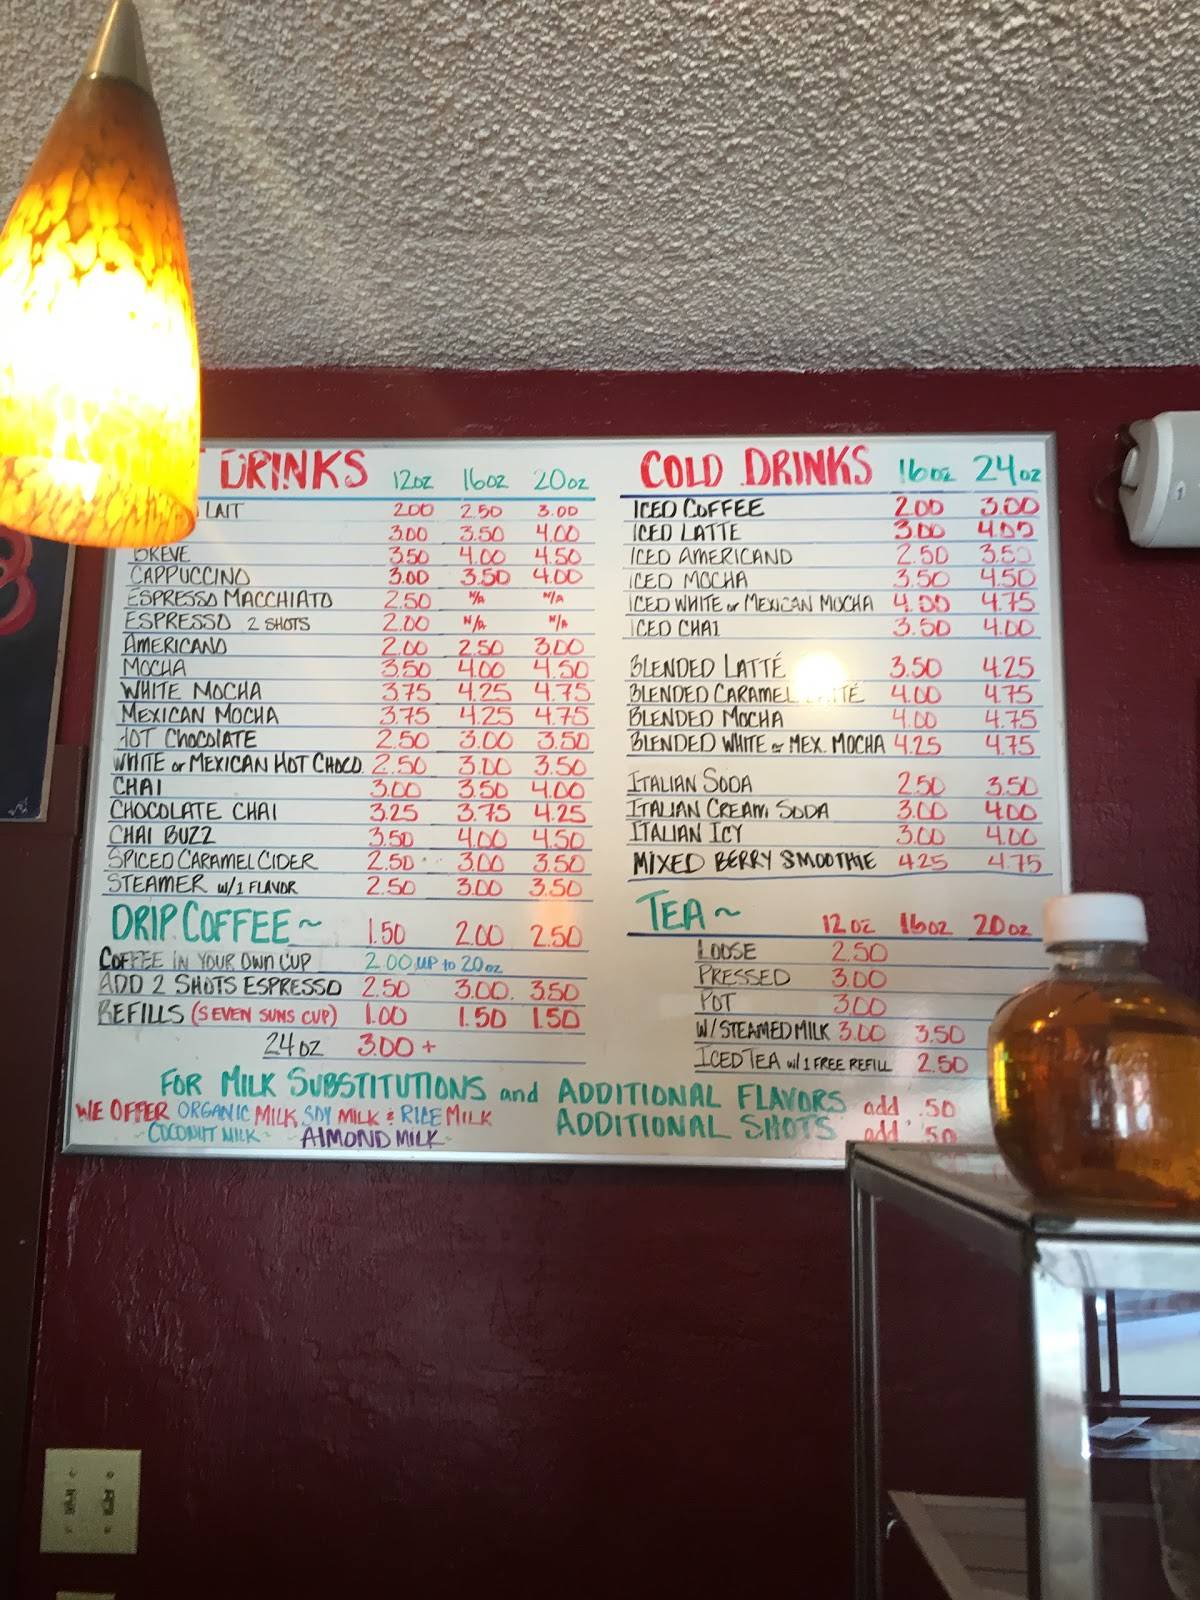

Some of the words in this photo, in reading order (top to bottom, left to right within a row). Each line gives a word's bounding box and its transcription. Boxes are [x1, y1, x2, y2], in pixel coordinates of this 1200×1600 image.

[220, 449, 369, 491] DRINKS
[640, 450, 723, 488] COLD
[743, 445, 873, 487] DRINKS
[206, 502, 245, 519] LAIT
[461, 504, 502, 519] 2.50
[537, 504, 578, 517] 3.00
[634, 500, 677, 519] ICED
[683, 498, 765, 518] COFFEE
[388, 524, 428, 542] 3.00
[460, 526, 505, 542] 3.50
[633, 523, 672, 542] ICED
[681, 522, 742, 541] LATTE
[630, 547, 670, 565] ICED
[896, 543, 949, 565] 2.50
[130, 566, 250, 586] CAPPUCCINO
[388, 567, 429, 585] 3.00
[630, 571, 672, 589] ICED
[684, 571, 748, 589] MOCHA
[893, 568, 950, 588] 3.50
[127, 588, 218, 607] ESPRESSO
[224, 589, 333, 608] MACCHIATO
[384, 590, 432, 609] 2.50
[630, 595, 670, 612] ICED
[675, 594, 723, 612] WHITE
[727, 603, 740, 612] or
[745, 594, 813, 613] MEXICAN
[820, 595, 873, 612] MOCHA
[125, 612, 231, 630] ESPRESSO
[248, 617, 259, 631] 2
[265, 617, 311, 631] SHOTS
[630, 619, 671, 636] ICED
[678, 619, 720, 636] CHAI
[893, 617, 951, 637] 3.50
[458, 639, 504, 656] 2.50
[123, 657, 186, 677] MOCHA
[381, 660, 432, 678] 3.50
[458, 658, 505, 678] 4.00
[533, 659, 589, 678] 4.50
[630, 654, 715, 678] BLENDED
[725, 652, 786, 678] LATTÉ
[890, 655, 942, 679] 3.50
[120, 680, 181, 700] WHITE
[193, 682, 262, 700] MOCHA
[382, 682, 431, 701] 3.75
[459, 682, 512, 701] 4.25
[534, 682, 591, 701] 4.75
[630, 683, 708, 703] BLENDED
[891, 684, 942, 704] 4.00
[121, 702, 204, 724] MEXICAN
[215, 703, 279, 724] MOCHA
[379, 706, 430, 725] 3.75
[460, 706, 514, 726] 4.25
[535, 706, 589, 726] 4.75
[629, 706, 713, 727] BLENDED
[723, 706, 783, 728] MOCHA
[892, 708, 937, 729] 4.00
[985, 709, 1037, 729] 4.75
[376, 729, 430, 750] 2.50
[459, 730, 514, 750] 3.00
[537, 731, 589, 750] 3.50
[631, 732, 715, 752] BLENDED
[722, 732, 765, 753] WHITE
[832, 733, 885, 754] MOCHA
[895, 734, 941, 755] 4.25
[171, 762, 183, 773] or
[190, 751, 269, 774] MEXICAN
[274, 751, 310, 773] HOT
[371, 753, 427, 774] 2.50
[534, 755, 587, 775] 3.50
[113, 776, 162, 796] CHAI
[370, 780, 422, 798] 3.00
[627, 770, 696, 793] ITALIAN
[703, 768, 752, 793] SODA
[110, 800, 223, 820] CHOCOLATE
[232, 802, 277, 820] CHAI
[370, 803, 418, 822] 3.25
[457, 803, 511, 822] 3.75
[534, 804, 586, 823] 4.25
[626, 798, 700, 818] ITALIAN
[776, 799, 829, 819] SODA
[897, 799, 948, 820] 3.00
[109, 824, 151, 844] CHAI
[164, 825, 216, 845] BUZZ
[630, 821, 700, 842] ITALIAN
[709, 822, 743, 843] ICY
[107, 848, 174, 869] SPICED
[177, 849, 255, 870] CARAMEL
[257, 849, 319, 870] CIDER
[367, 851, 414, 870] 2.50
[457, 852, 504, 872] 3.00
[633, 851, 705, 875] MIXED
[715, 849, 772, 872] BERRY
[107, 874, 208, 893] STEAMER
[249, 880, 298, 895] FLAVOR
[367, 876, 415, 895] 2.50
[457, 878, 503, 897] 3.00
[635, 889, 705, 931] TEA
[112, 904, 177, 942] DRIP
[183, 900, 291, 943] COFFEE
[368, 917, 405, 945] 1.50
[456, 920, 504, 947] 2.00
[530, 924, 583, 948] 2.50
[100, 946, 163, 970] COFFEE
[200, 953, 233, 971] YOUR
[279, 953, 312, 970] CUP
[416, 956, 438, 971] UP
[697, 939, 758, 960] LOOSE
[831, 941, 888, 963] 2.50
[100, 973, 143, 995] ADD
[152, 975, 165, 995] 2
[175, 974, 237, 995] SHOTS
[243, 977, 342, 995] ESPRESSO
[361, 976, 411, 998] 2.50
[700, 965, 791, 987] PRESSED
[700, 989, 737, 1013] POT
[99, 1000, 184, 1024] REFILLS
[192, 1001, 251, 1027] (SEVEN
[260, 1007, 295, 1022] SUNS
[301, 1004, 337, 1027] CUP)
[365, 1002, 407, 1026] 1.00
[459, 1006, 507, 1029] 1.50
[795, 1022, 831, 1041] MILK
[914, 1024, 966, 1044] 3.50
[694, 1045, 743, 1067] ICED
[742, 1048, 781, 1070] TEA
[814, 1056, 846, 1072] FREE
[850, 1058, 893, 1072] REFILL
[918, 1052, 968, 1074] 2.50
[161, 1068, 202, 1096] FOR
[221, 1065, 276, 1098] MILK
[287, 1067, 487, 1101] SUBSTITUTIONS
[500, 1081, 538, 1104] and
[558, 1077, 721, 1109] ADDITIONAL
[737, 1083, 847, 1113] FLAVORS
[864, 1095, 899, 1116] add
[76, 1099, 104, 1121] WE
[110, 1099, 170, 1121] OFFER
[177, 1102, 249, 1120] ORGANIC
[303, 1107, 331, 1125] SOY
[338, 1109, 379, 1126] MILK
[401, 1104, 442, 1125] RICE
[446, 1104, 493, 1126] MILK
[557, 1108, 731, 1140] ADDITIONAL
[740, 1115, 837, 1141] SHOTS
[397, 1130, 445, 1148] MILK
